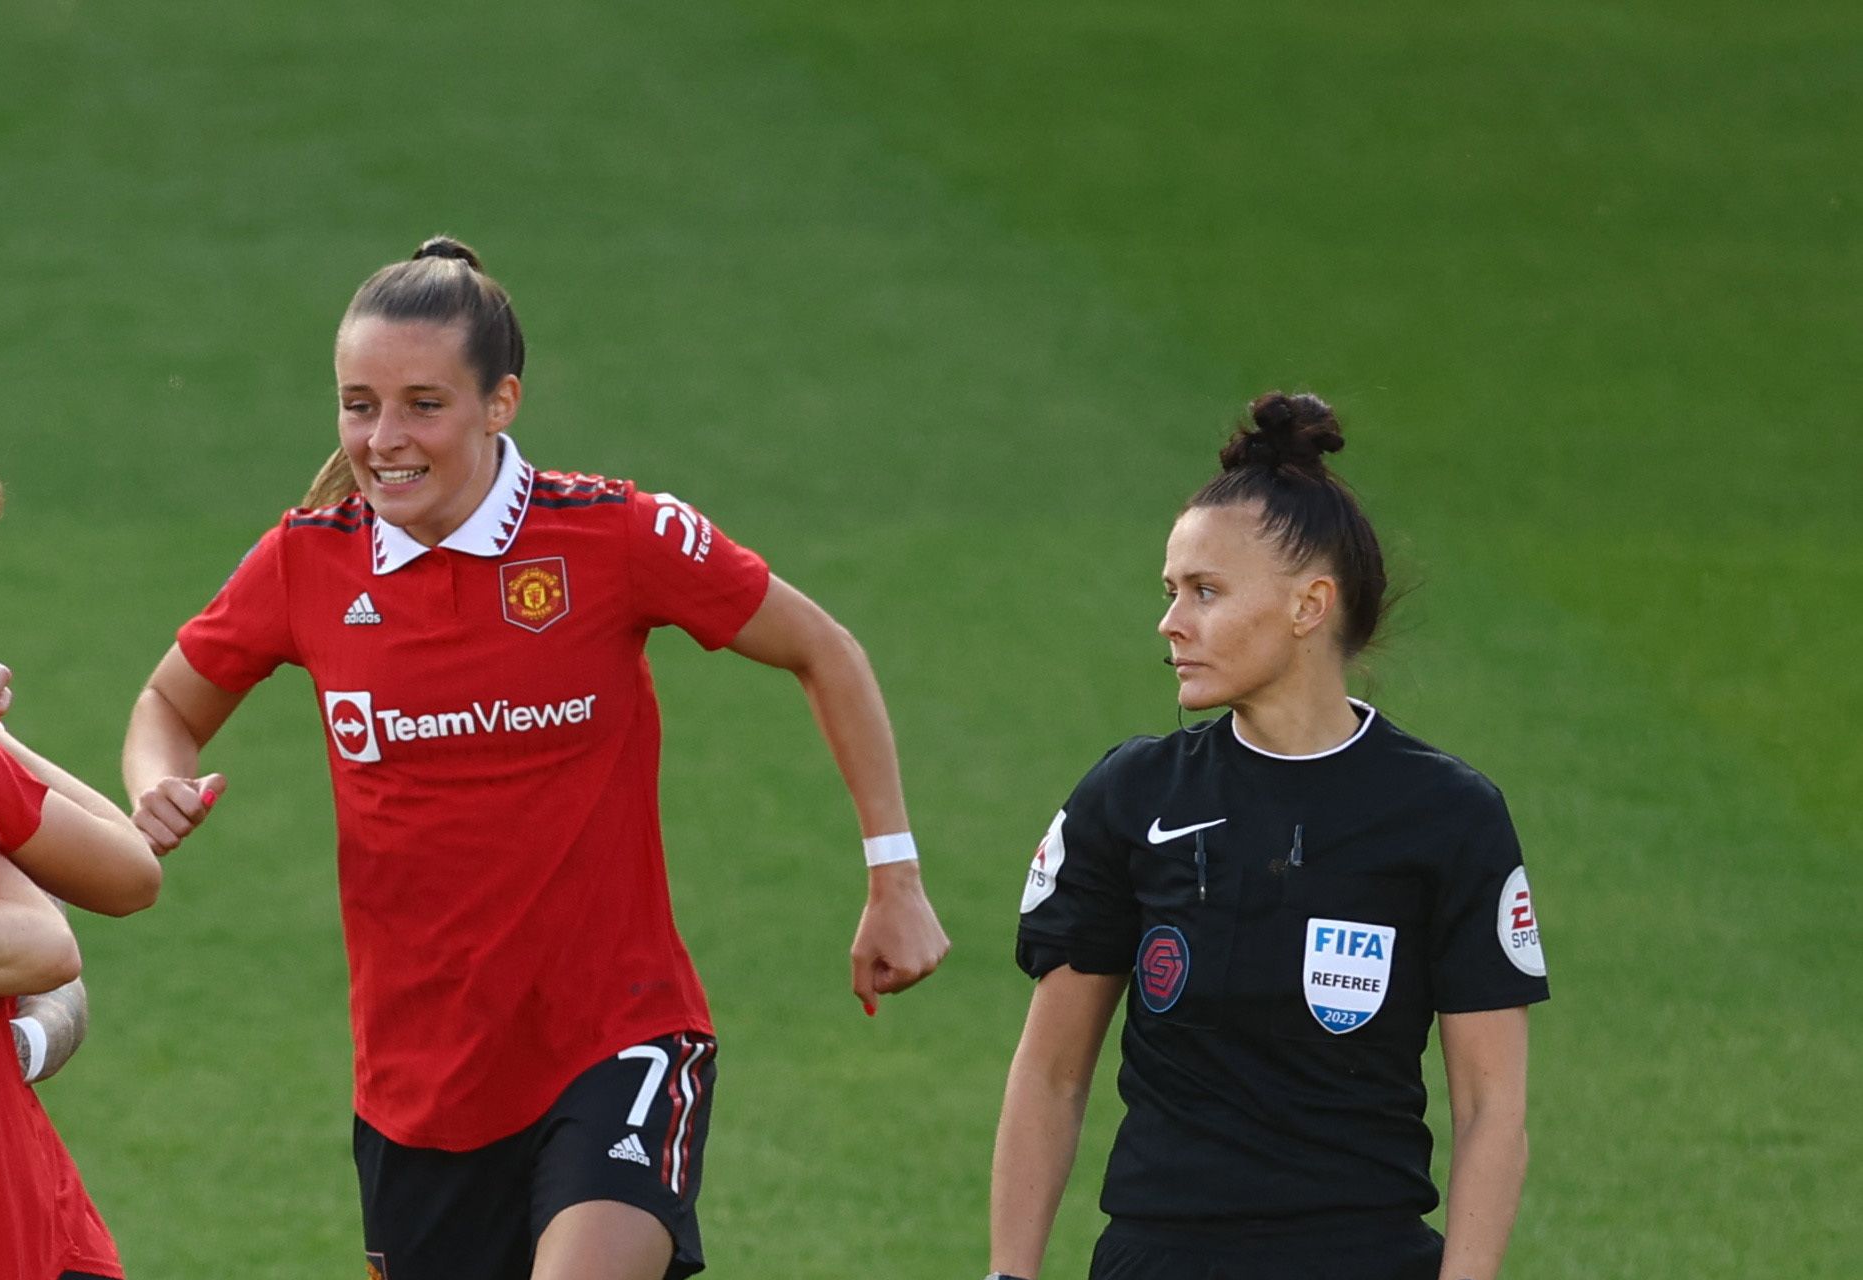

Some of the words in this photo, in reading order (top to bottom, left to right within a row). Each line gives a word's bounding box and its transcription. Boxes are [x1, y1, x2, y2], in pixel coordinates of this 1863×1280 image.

[343, 611, 381, 625] adidas
[375, 694, 596, 742] TeamViewer
[1314, 927, 1384, 960] FIFA
[1310, 971, 1381, 993] REFEREE
[1323, 1010, 1357, 1025] 2023
[618, 1045, 669, 1127] 7
[608, 1148, 651, 1167] adidas
